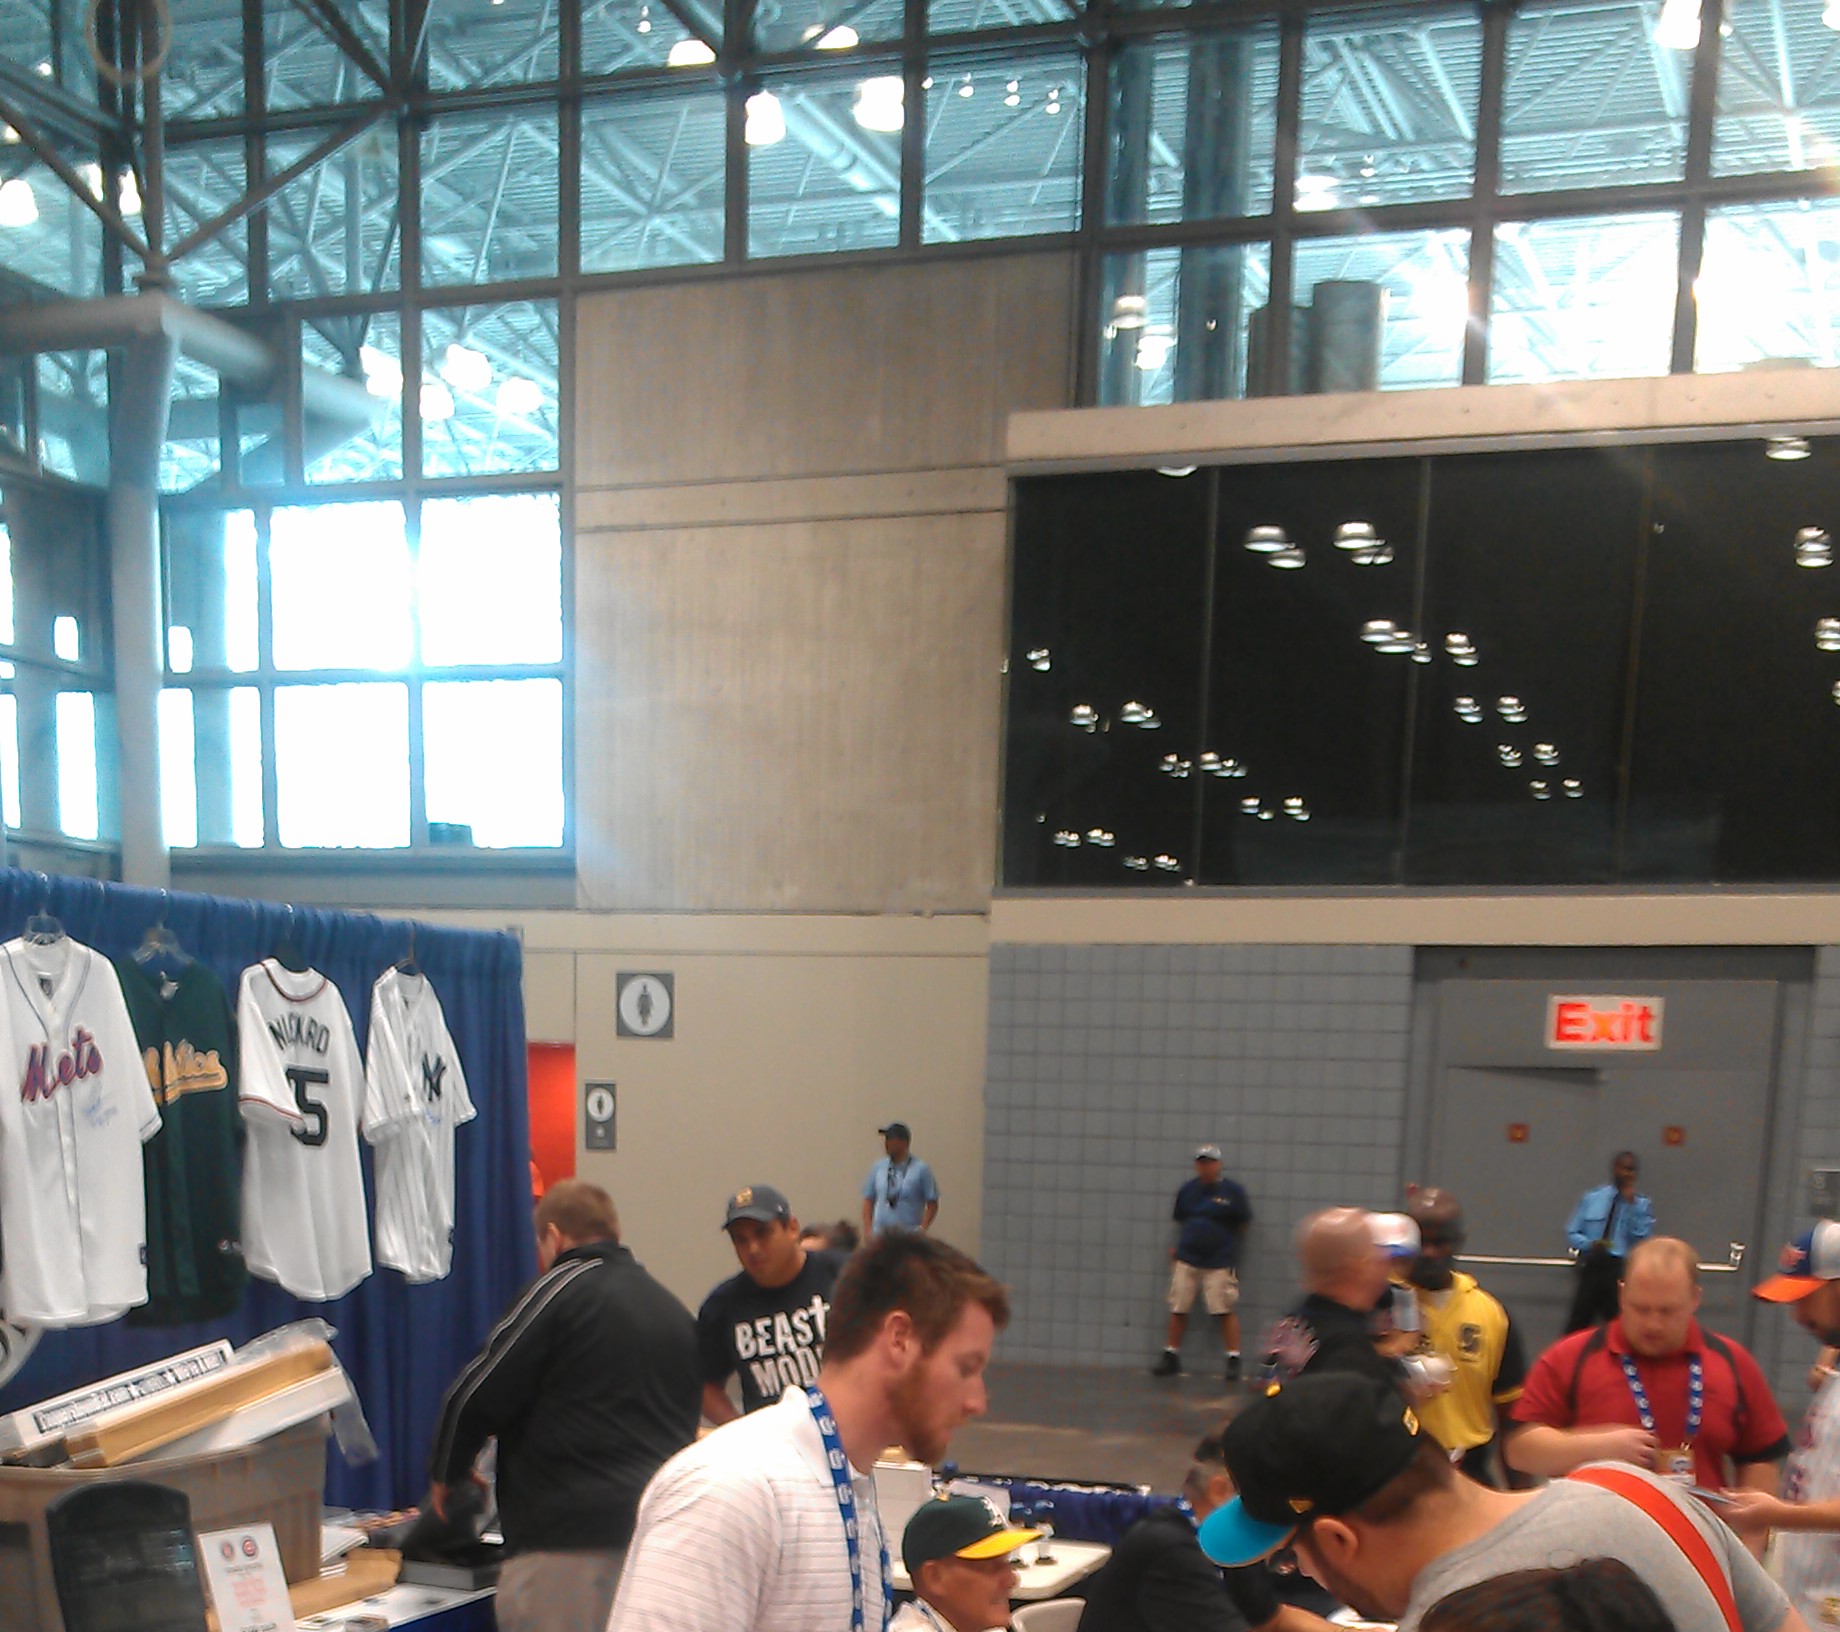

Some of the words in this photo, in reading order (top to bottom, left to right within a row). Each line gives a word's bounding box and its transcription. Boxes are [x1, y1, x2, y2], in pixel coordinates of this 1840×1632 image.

[1555, 1001, 1654, 1043] Exit
[21, 1024, 104, 1103] Mets
[421, 1052, 447, 1102] NY
[284, 1064, 331, 1147] 5
[734, 1293, 831, 1360] BEAST
[749, 1344, 825, 1398] MOD
